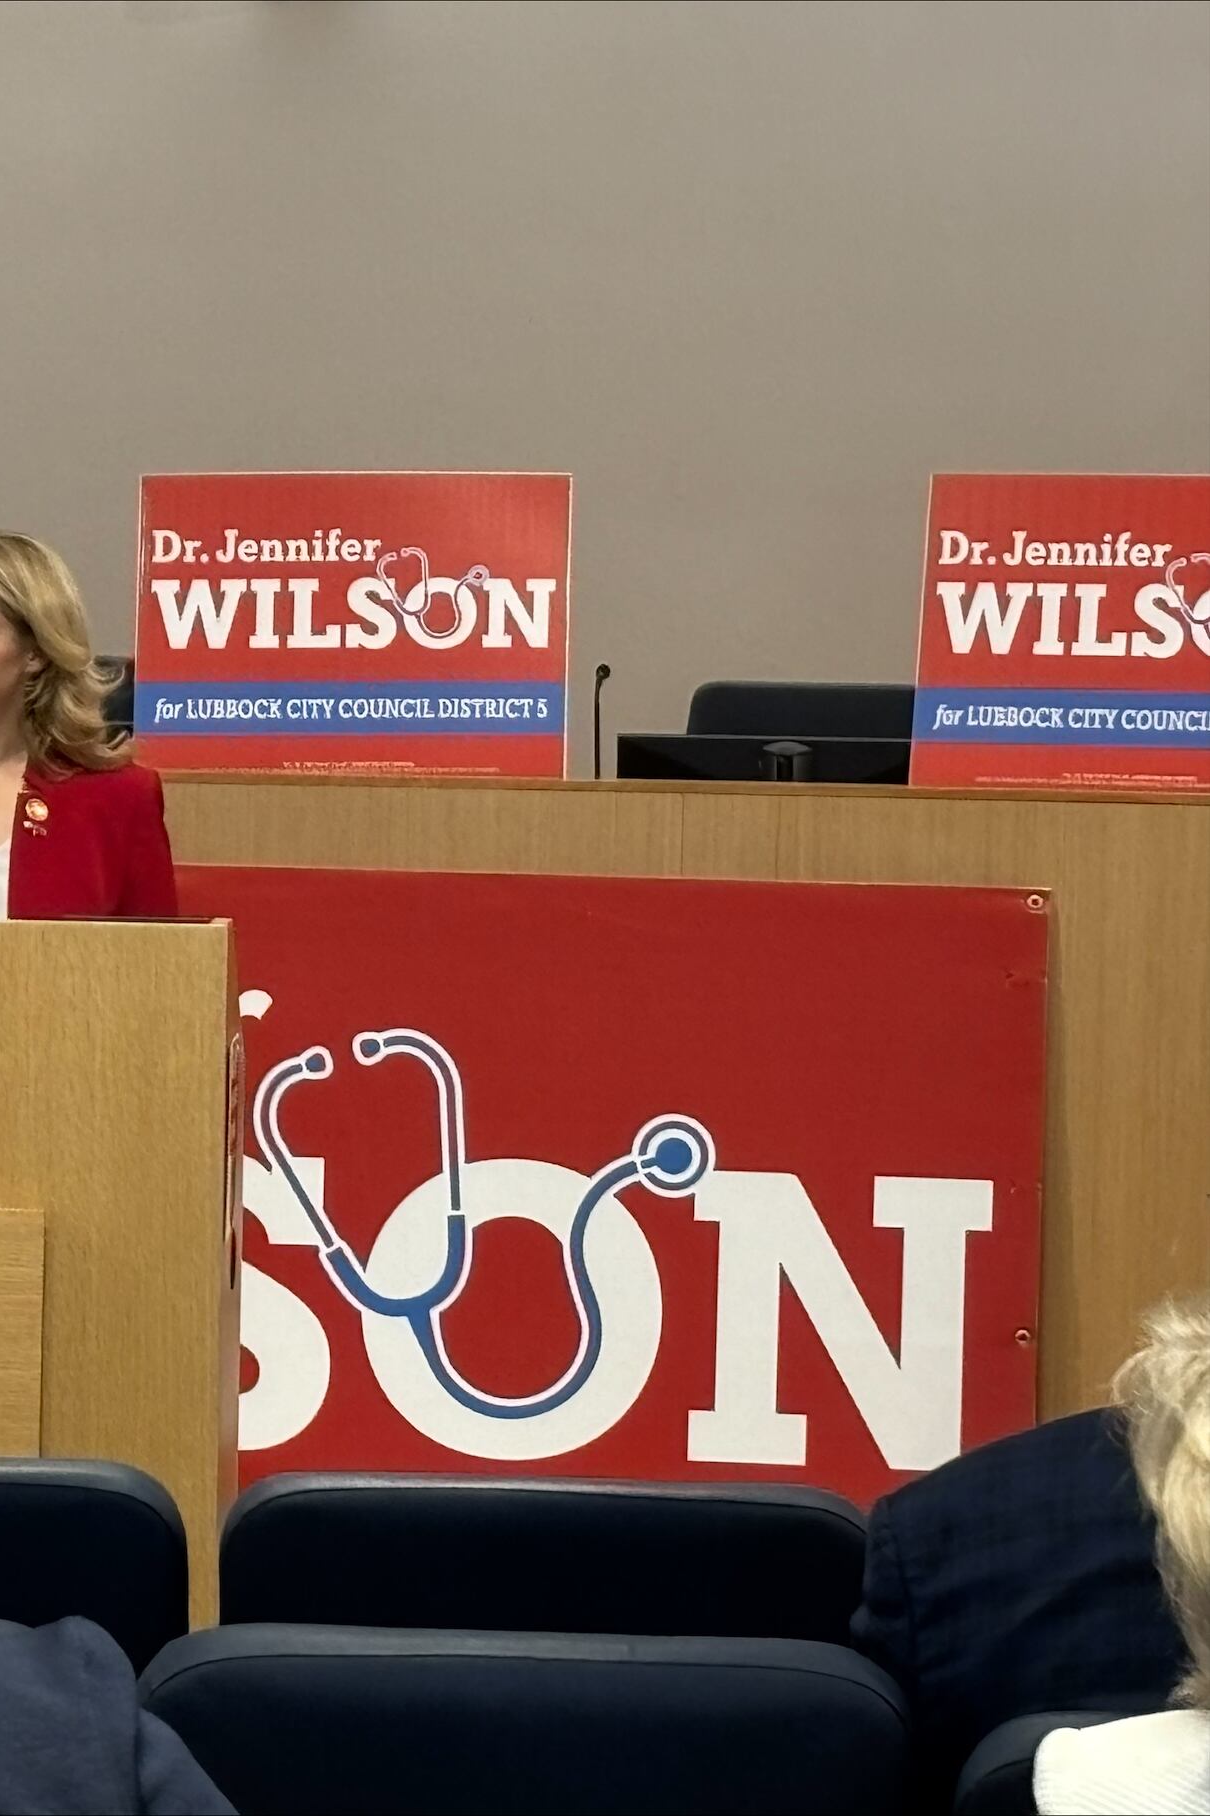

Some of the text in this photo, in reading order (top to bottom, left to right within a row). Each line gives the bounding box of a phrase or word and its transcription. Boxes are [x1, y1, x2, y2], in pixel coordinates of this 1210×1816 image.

[152, 528, 382, 563] Dr. Jennifer
[938, 530, 1172, 568] Dr. Jennifer
[151, 577, 557, 650] WILSON
[936, 581, 1210, 660] WILS
[154, 698, 548, 723] for LUBBOCK CITY COUNCIL DISTRICT 5
[932, 704, 1210, 732] for LUBBOCK CITY COUNCI
